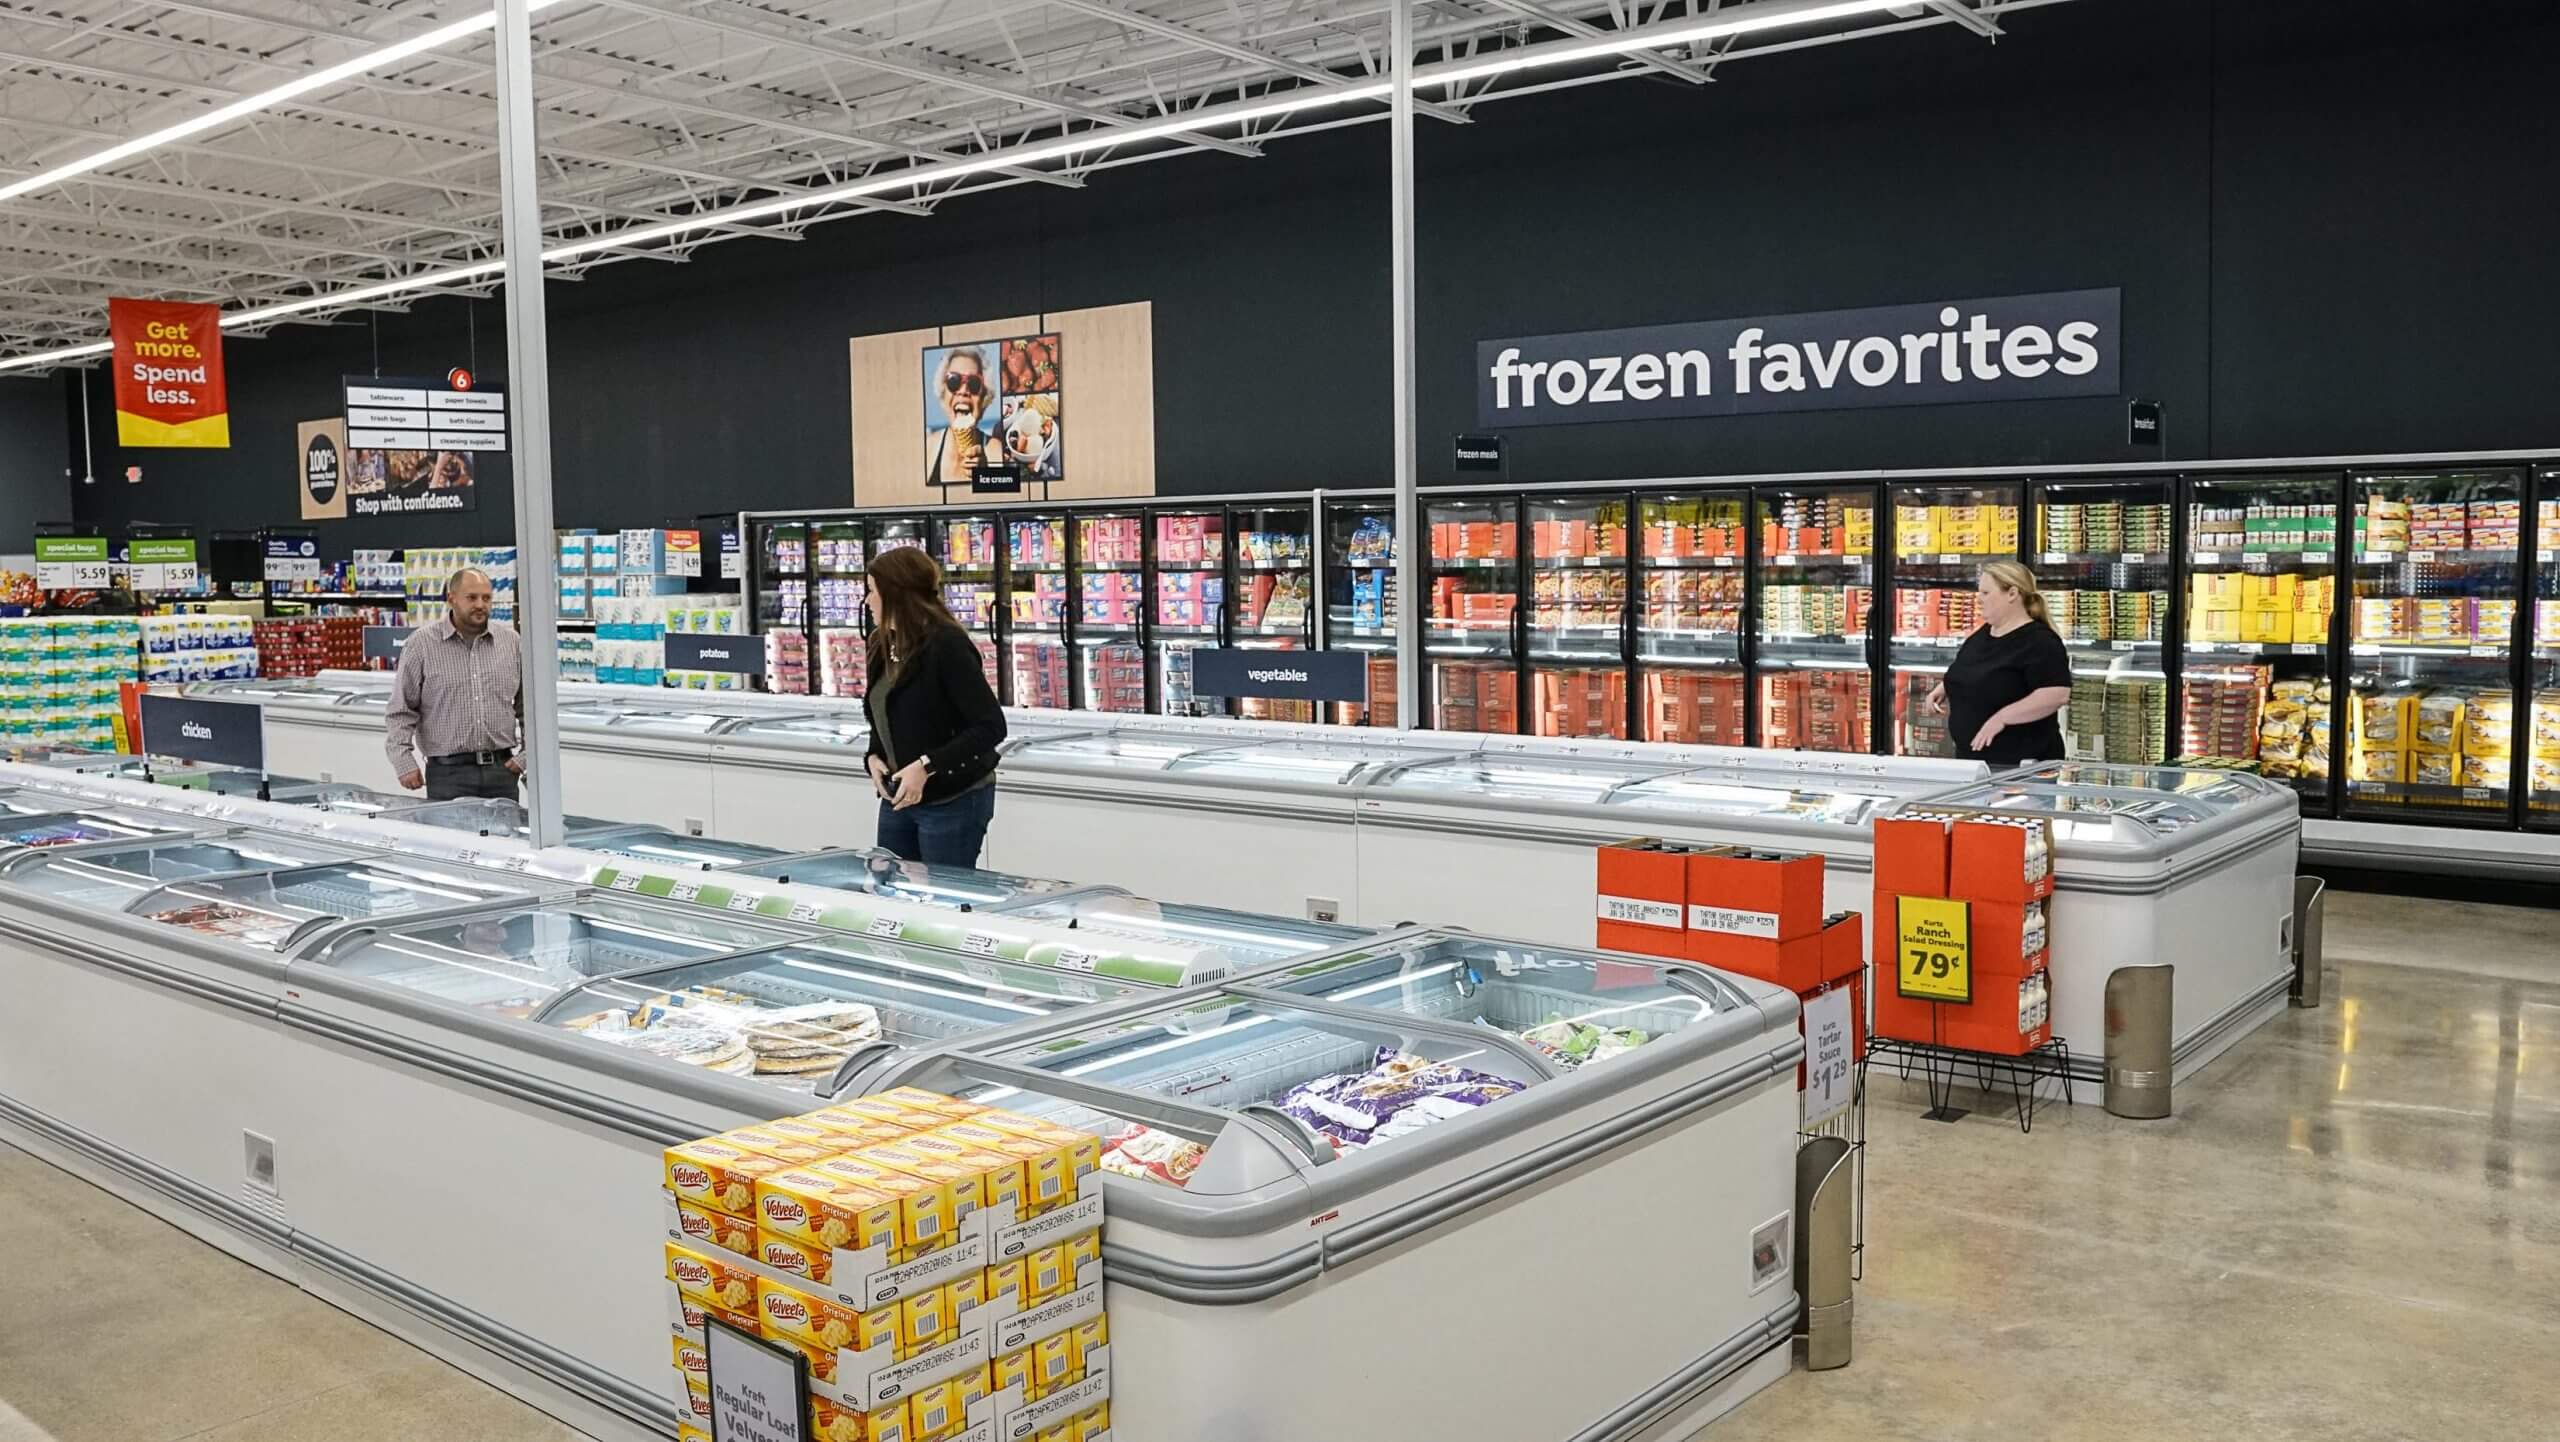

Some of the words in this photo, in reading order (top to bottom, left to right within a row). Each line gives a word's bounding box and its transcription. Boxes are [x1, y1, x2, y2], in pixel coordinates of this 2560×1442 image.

[146, 321, 189, 340] Get
[135, 340, 201, 358] more.
[1491, 348, 1711, 409] frozen
[1729, 306, 2099, 395] favorites
[133, 363, 206, 384] Spend
[456, 373, 467, 388] 6
[146, 385, 196, 404] less.
[309, 449, 336, 472] 100%
[1457, 448, 1479, 459] frozen
[979, 474, 990, 484] ice
[991, 475, 1013, 485] cream
[356, 498, 379, 515] Shop
[381, 494, 403, 512] with
[404, 492, 463, 510] confidence.
[699, 648, 729, 660] potatoes
[1248, 668, 1308, 683] vegetables
[182, 721, 212, 740] chicken
[1916, 926, 1951, 938] Ranch
[1903, 935, 1927, 945] Salad
[1928, 938, 1965, 951] Dressing
[1818, 1030, 1842, 1049] Tartar
[1819, 1045, 1841, 1064] Sauce
[672, 1166, 709, 1184] Velveeta
[724, 1169, 751, 1185] Original
[766, 1201, 805, 1217] Velveeta
[822, 1204, 850, 1220] Original
[725, 1217, 751, 1232] Original
[767, 1249, 805, 1266] Velveeta
[674, 1261, 708, 1279] Velveeta
[724, 1265, 751, 1281] Original
[685, 1307, 705, 1322] elvee
[767, 1297, 806, 1316] Velveeta
[823, 1304, 852, 1321] Original
[727, 1312, 754, 1328] Original
[682, 1351, 707, 1369] Velvee
[741, 1383, 766, 1406] Kraft
[691, 1395, 711, 1412] elvee
[716, 1384, 764, 1422] Regular
[767, 1411, 796, 1439] Loaf
[830, 1400, 861, 1417] Original
[724, 1411, 779, 1442] Velvee
